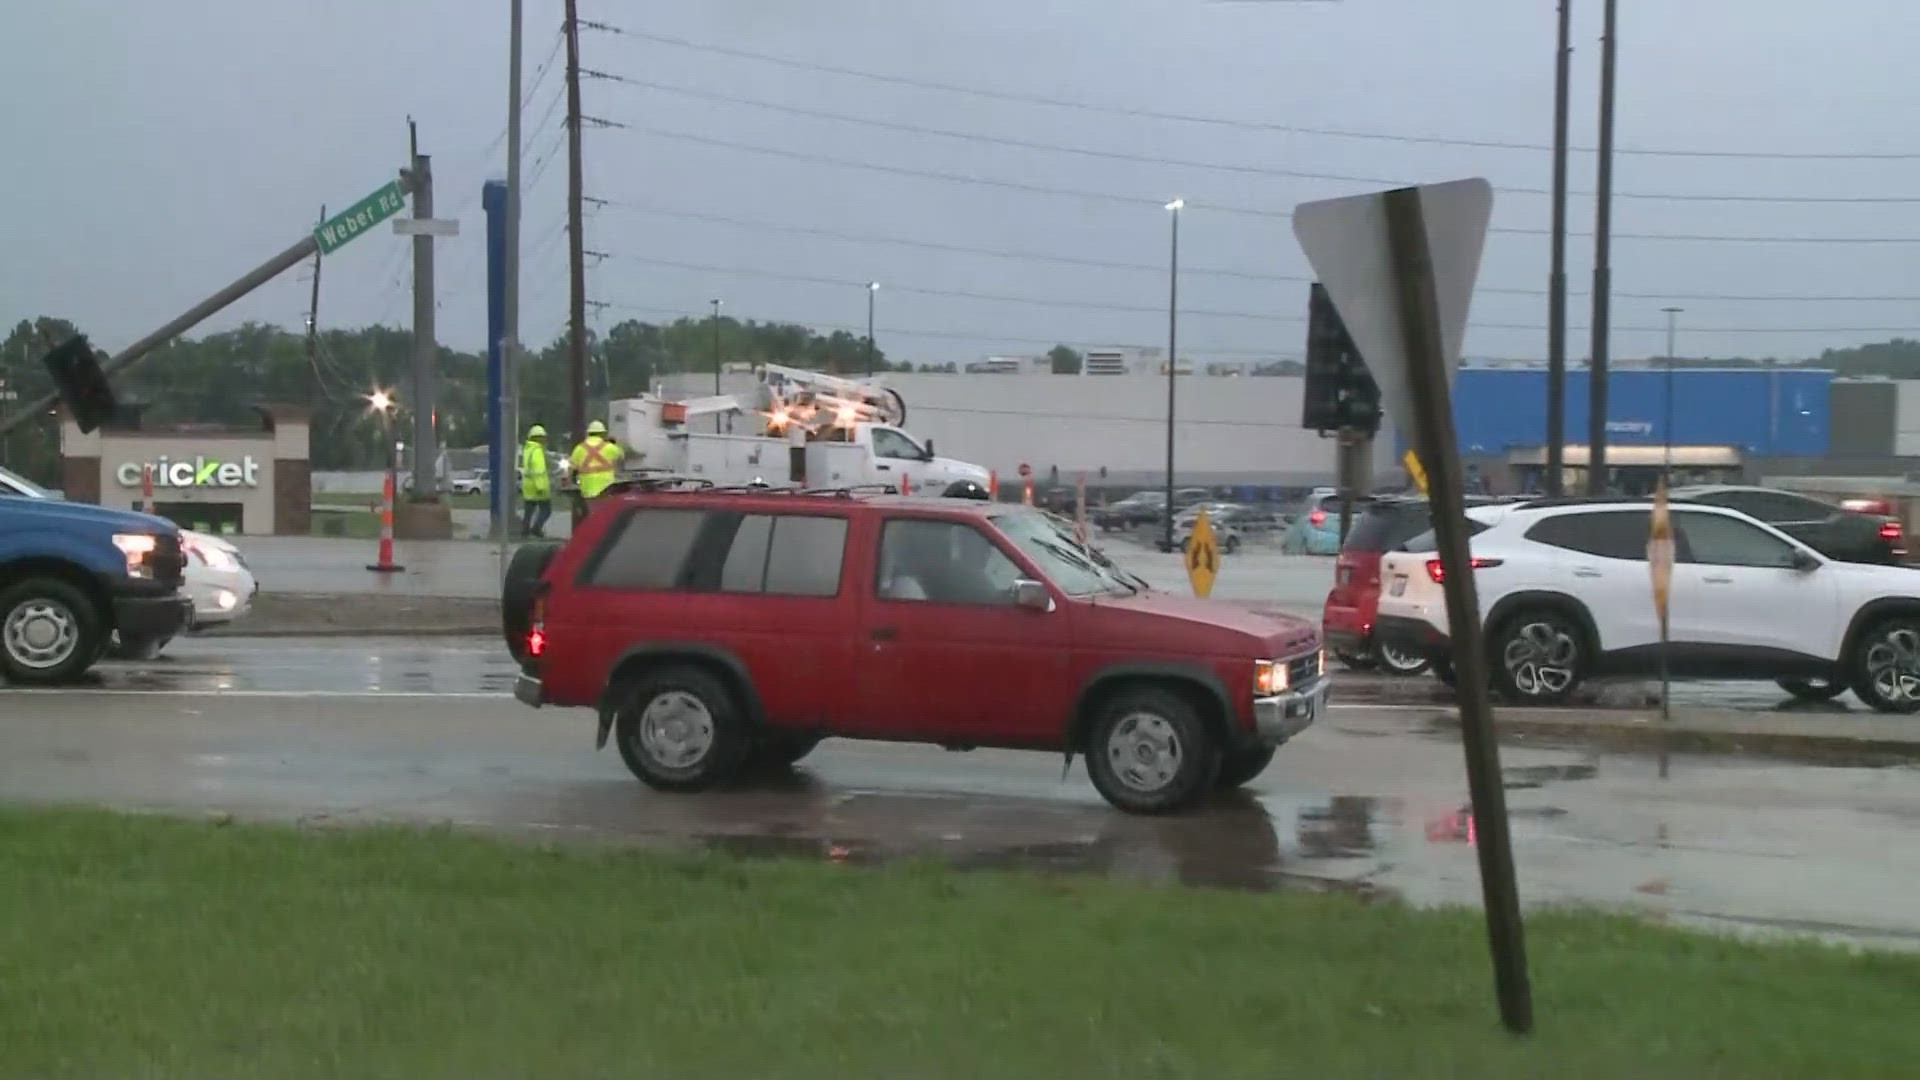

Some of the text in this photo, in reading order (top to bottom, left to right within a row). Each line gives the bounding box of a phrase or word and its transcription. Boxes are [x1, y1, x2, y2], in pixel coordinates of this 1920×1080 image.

[321, 191, 399, 247] Weber Rd
[117, 455, 259, 487] cricket
